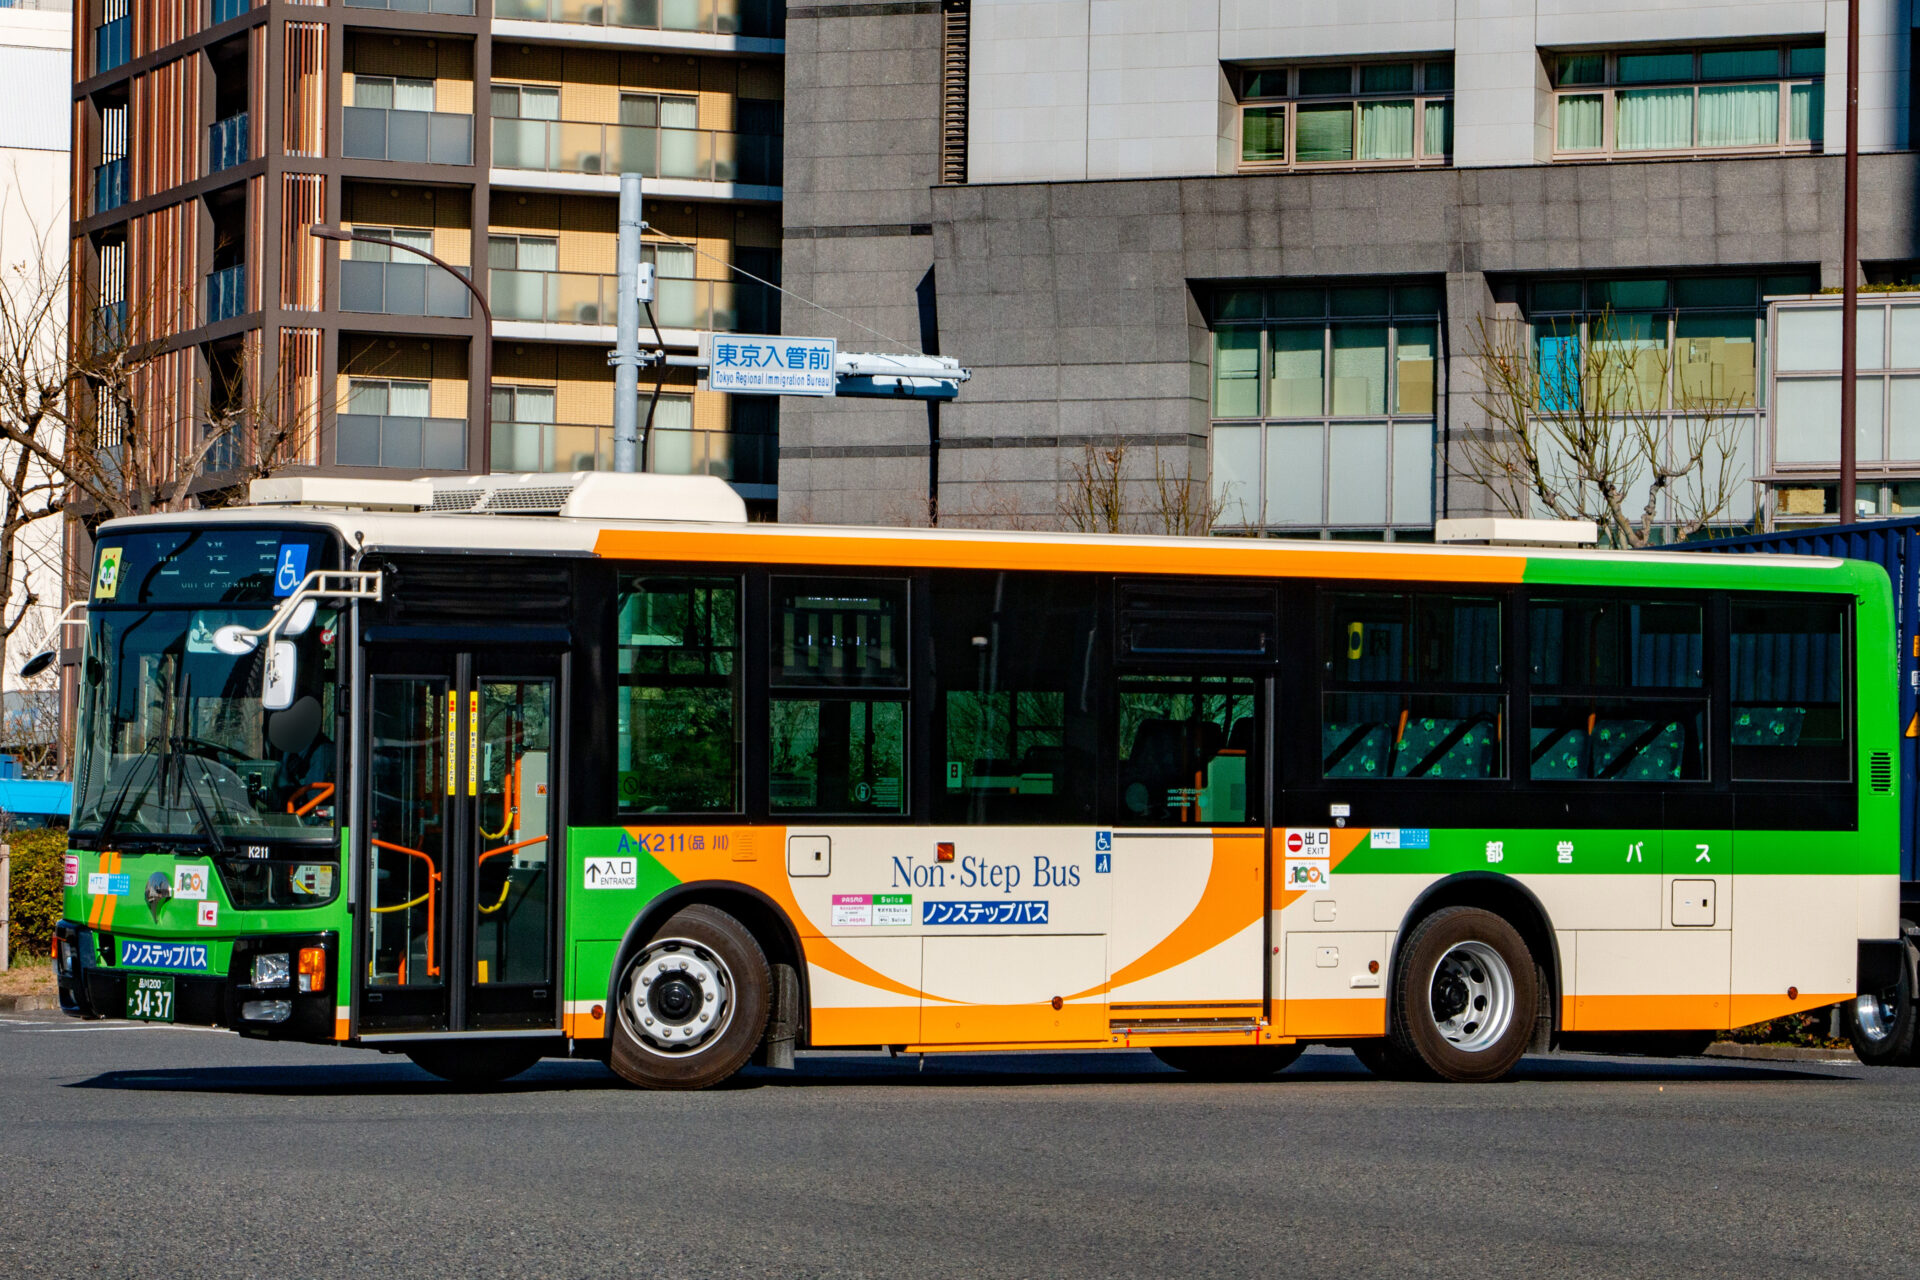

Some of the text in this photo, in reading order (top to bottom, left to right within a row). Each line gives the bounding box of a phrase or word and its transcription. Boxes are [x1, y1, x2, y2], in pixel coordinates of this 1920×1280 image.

[716, 343, 830, 370] 東京入管前
[716, 371, 829, 387] Tokyo Regional Immigration Bureau
[1305, 831, 1328, 845] 出口
[1373, 832, 1391, 840] HTT
[248, 846, 269, 859] K211
[1307, 847, 1325, 855] EXIT
[604, 861, 631, 875] 入口
[1033, 855, 1081, 888] Bus
[600, 877, 635, 886] ENTRANCE
[841, 896, 864, 904] PASMO
[923, 902, 1048, 923] ノンステップバス
[122, 943, 207, 967] ノンステップバス
[138, 978, 162, 989] 品川200
[134, 989, 172, 1018] 34-37
